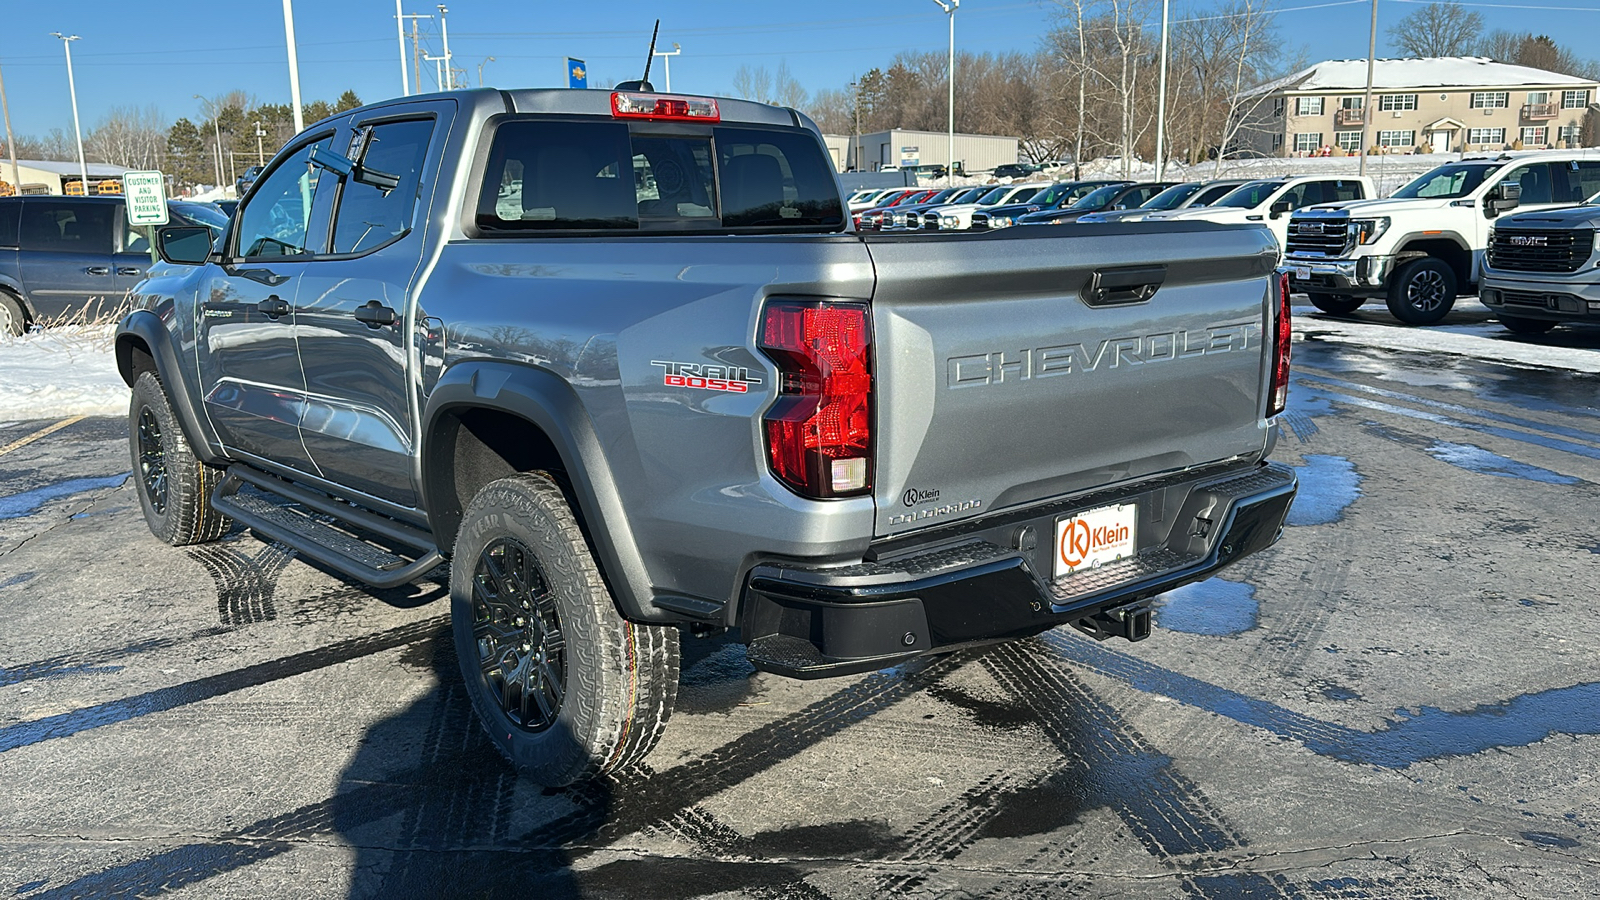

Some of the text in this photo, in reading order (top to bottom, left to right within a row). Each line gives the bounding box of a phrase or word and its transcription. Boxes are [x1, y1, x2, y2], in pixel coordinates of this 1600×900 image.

[1510, 236, 1547, 246] GMC
[947, 322, 1257, 389] CHEVROLET
[651, 360, 762, 384] TRAIL
[664, 375, 748, 393] BOSS
[919, 488, 940, 500] Klein
[889, 500, 981, 525] COLORADO
[1092, 523, 1128, 547] Klein
